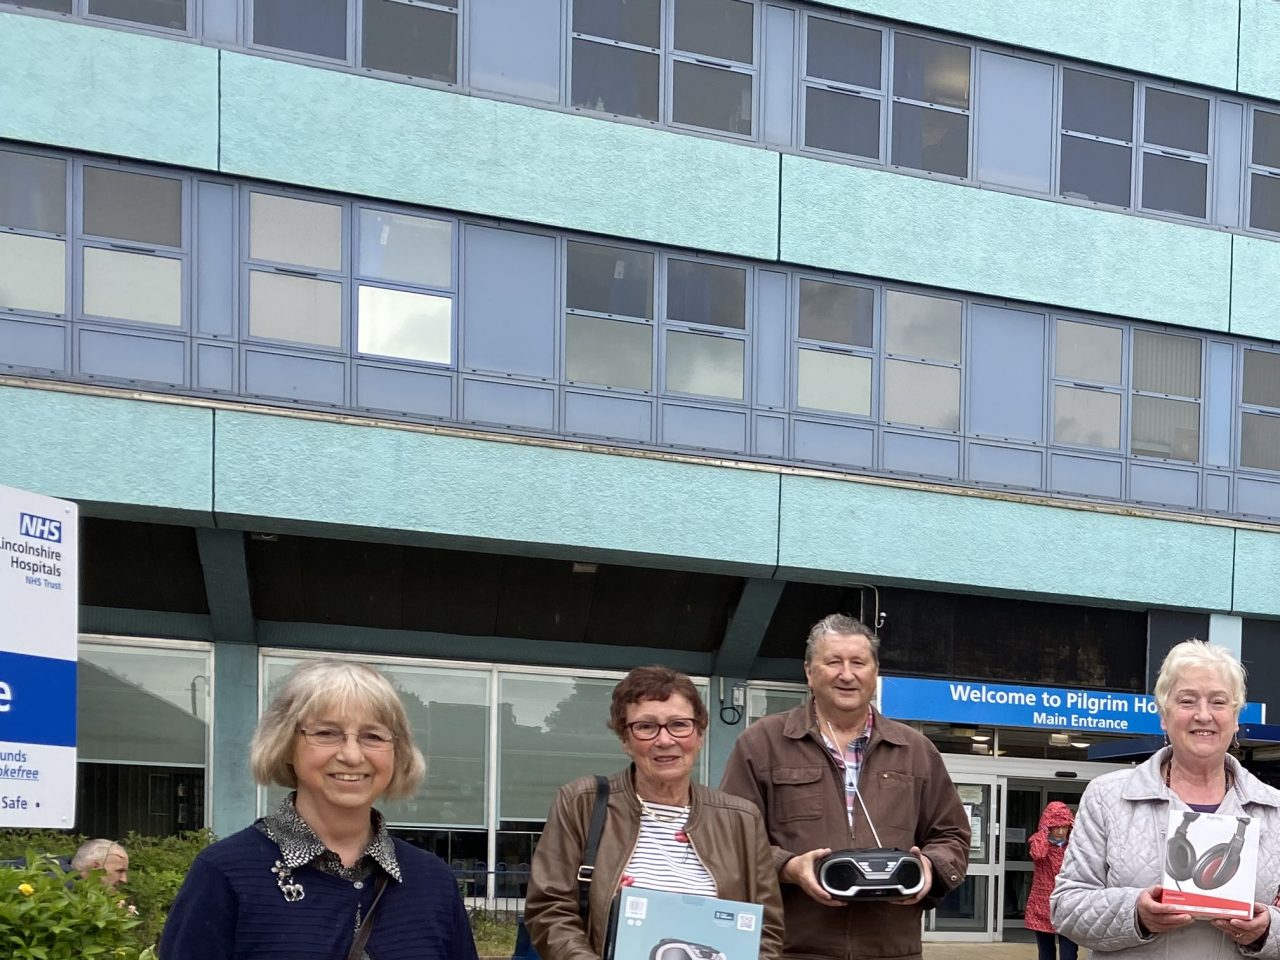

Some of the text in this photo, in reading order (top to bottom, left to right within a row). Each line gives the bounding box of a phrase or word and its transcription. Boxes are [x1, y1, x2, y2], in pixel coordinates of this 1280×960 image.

[20, 513, 61, 542] NHS
[0, 537, 62, 561] incolnshire
[11, 556, 62, 577] Hospitals
[26, 576, 62, 590] NHS Trust
[950, 684, 1037, 706] Welcome
[1042, 692, 1061, 708] to
[1067, 692, 1128, 714] Pilgrim
[1033, 711, 1129, 730] Main Entrance
[2, 795, 28, 810] Safe
